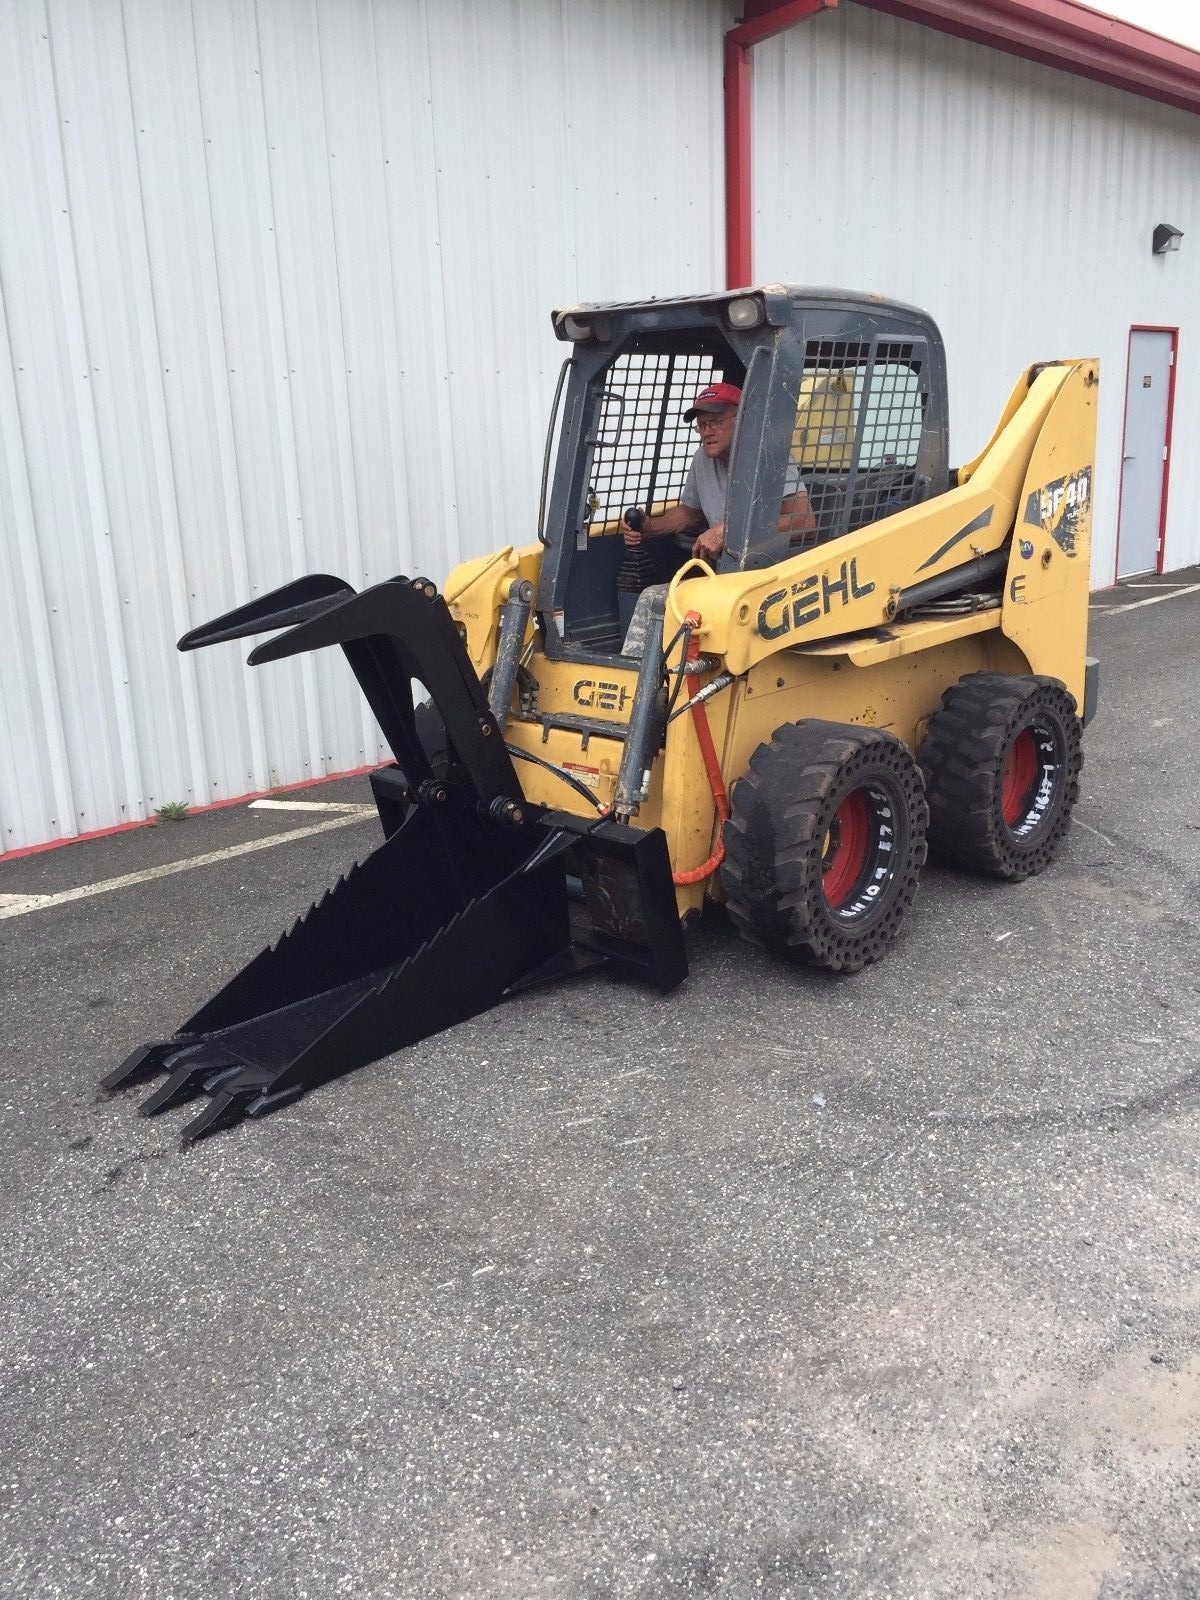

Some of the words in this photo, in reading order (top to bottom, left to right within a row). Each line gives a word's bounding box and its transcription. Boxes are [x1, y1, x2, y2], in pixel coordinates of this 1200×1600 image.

[758, 556, 875, 640] GEHL
[1010, 575, 1026, 603] E
[573, 680, 633, 711] GEH
